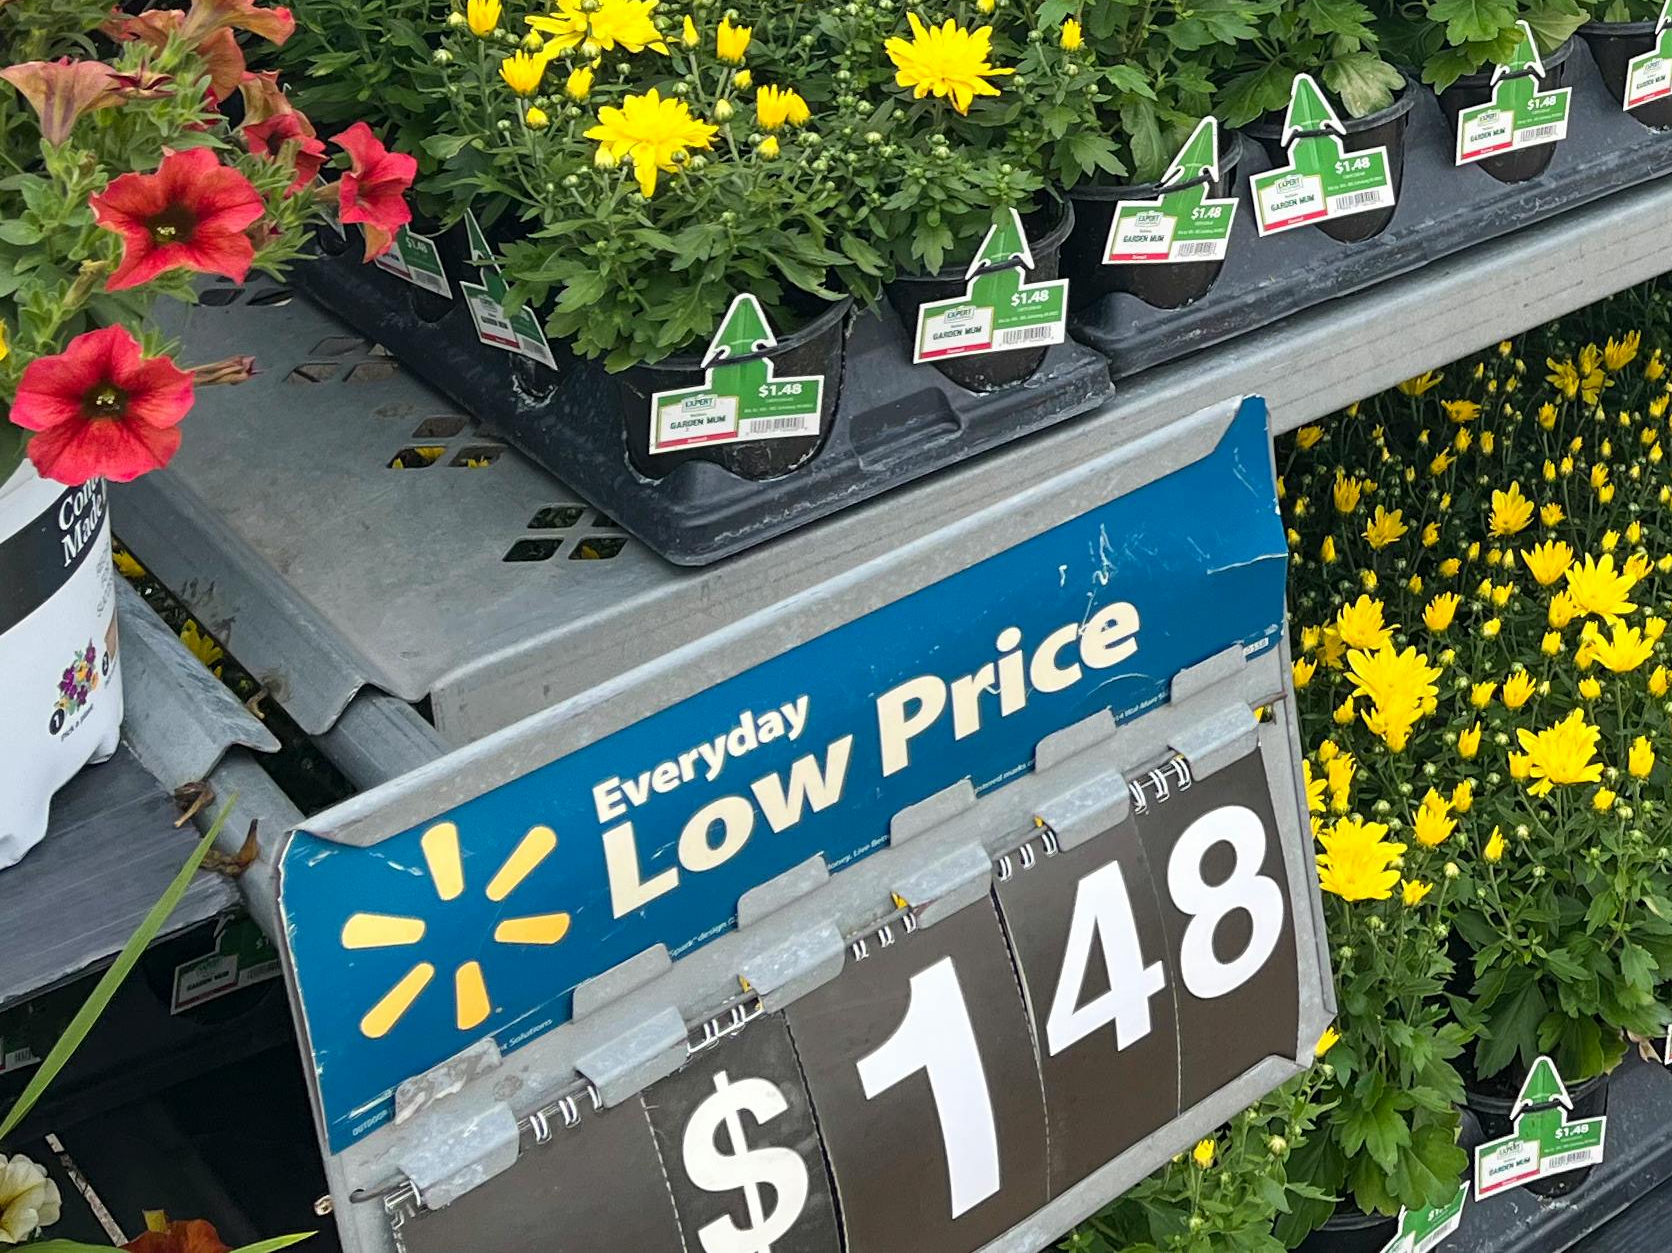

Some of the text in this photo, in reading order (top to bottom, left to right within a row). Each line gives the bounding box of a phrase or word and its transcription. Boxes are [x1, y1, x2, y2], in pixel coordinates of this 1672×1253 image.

[1527, 96, 1556, 110] $1.48
[1470, 127, 1506, 143] GARDEN MUM
[1335, 157, 1371, 174] $1.48
[1271, 200, 1297, 212] GARDEN
[1300, 194, 1314, 205] MUM
[1191, 207, 1222, 220] $1.48
[1123, 235, 1148, 243] GARDEN
[1011, 290, 1049, 307] $1.48
[947, 309, 972, 319] EXPERT
[932, 326, 982, 341] GARDEN MUM
[758, 383, 802, 398] $1.48
[685, 397, 713, 408] EXPERT
[670, 415, 726, 430] GARDEN MUM
[593, 694, 809, 823] Everyday
[602, 601, 1141, 920] Low Price
[1554, 1124, 1589, 1139] $1.48
[1488, 1156, 1531, 1176] GARDEN MUM
